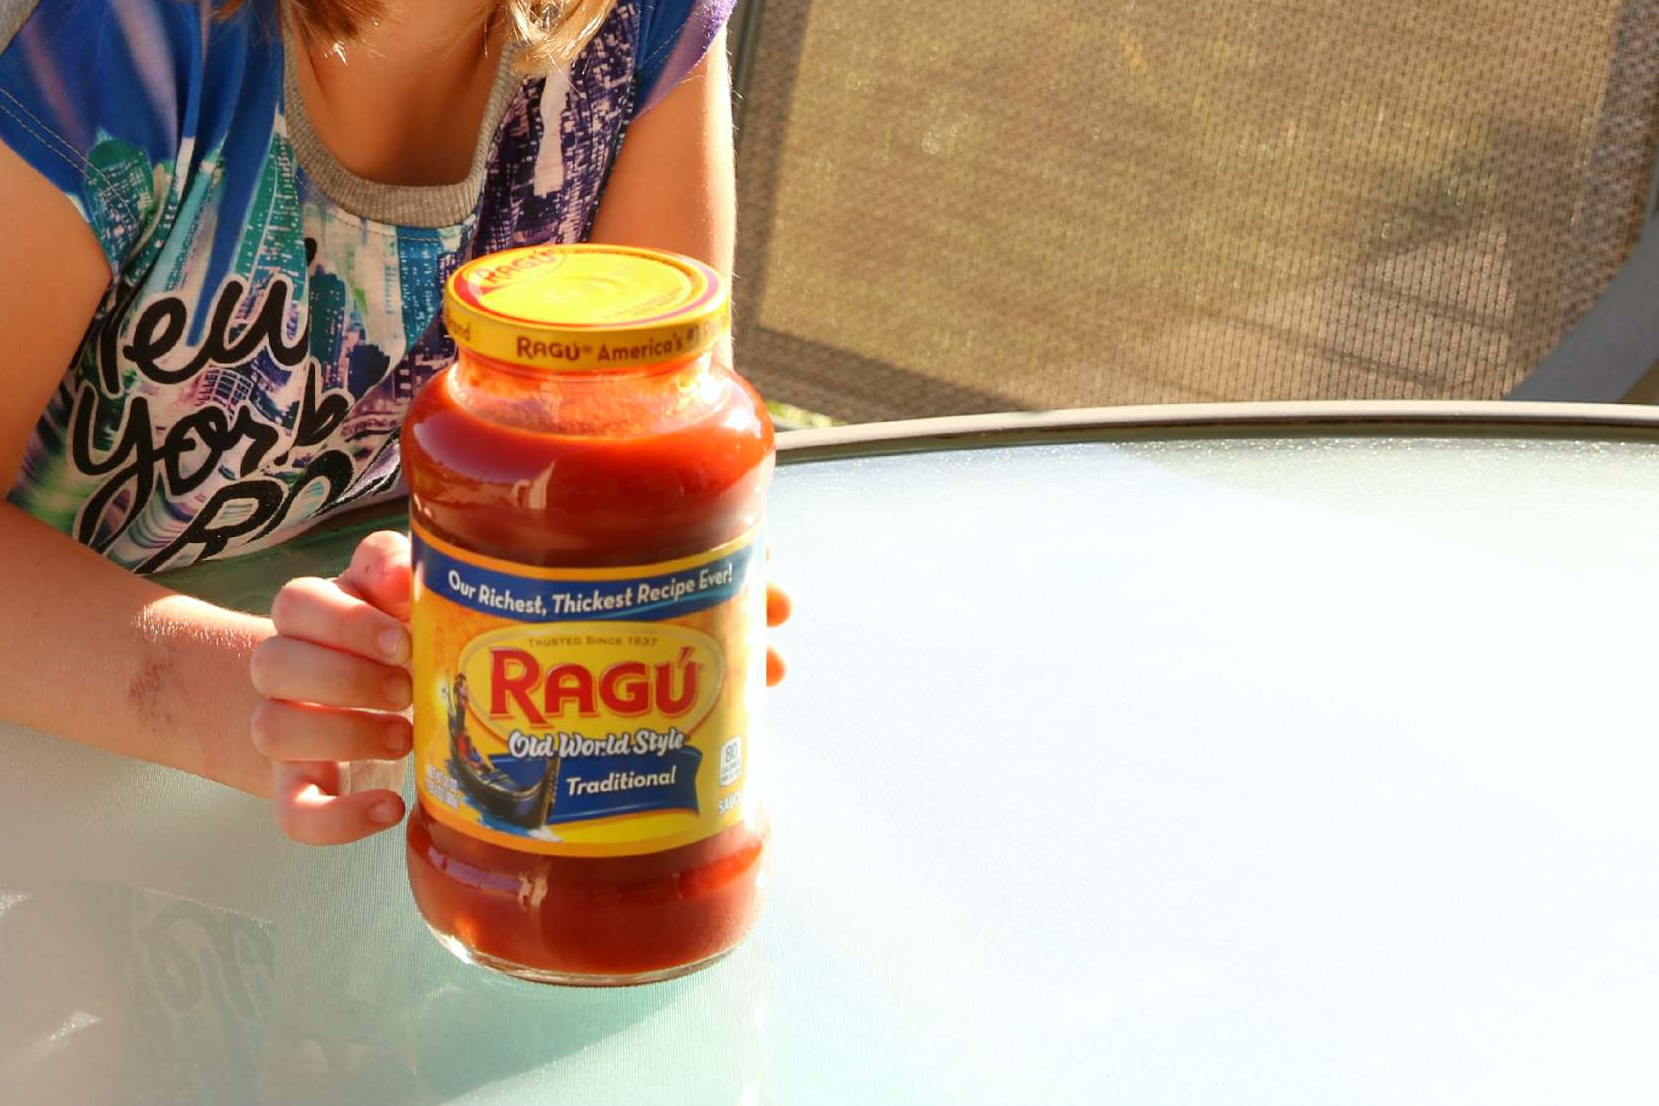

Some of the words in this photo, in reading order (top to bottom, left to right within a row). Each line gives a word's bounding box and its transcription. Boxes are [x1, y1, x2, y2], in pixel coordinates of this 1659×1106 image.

[598, 332, 683, 361] America's
[447, 569, 477, 599] Our
[478, 583, 547, 617] Richest,
[552, 587, 633, 614] Thickest
[637, 578, 695, 604] Recipe
[698, 562, 734, 590] Ever!
[488, 645, 705, 731] RAGÚ
[508, 729, 555, 760] Old
[558, 731, 631, 759] World
[632, 727, 686, 758] Style
[565, 765, 678, 797] Traditional
